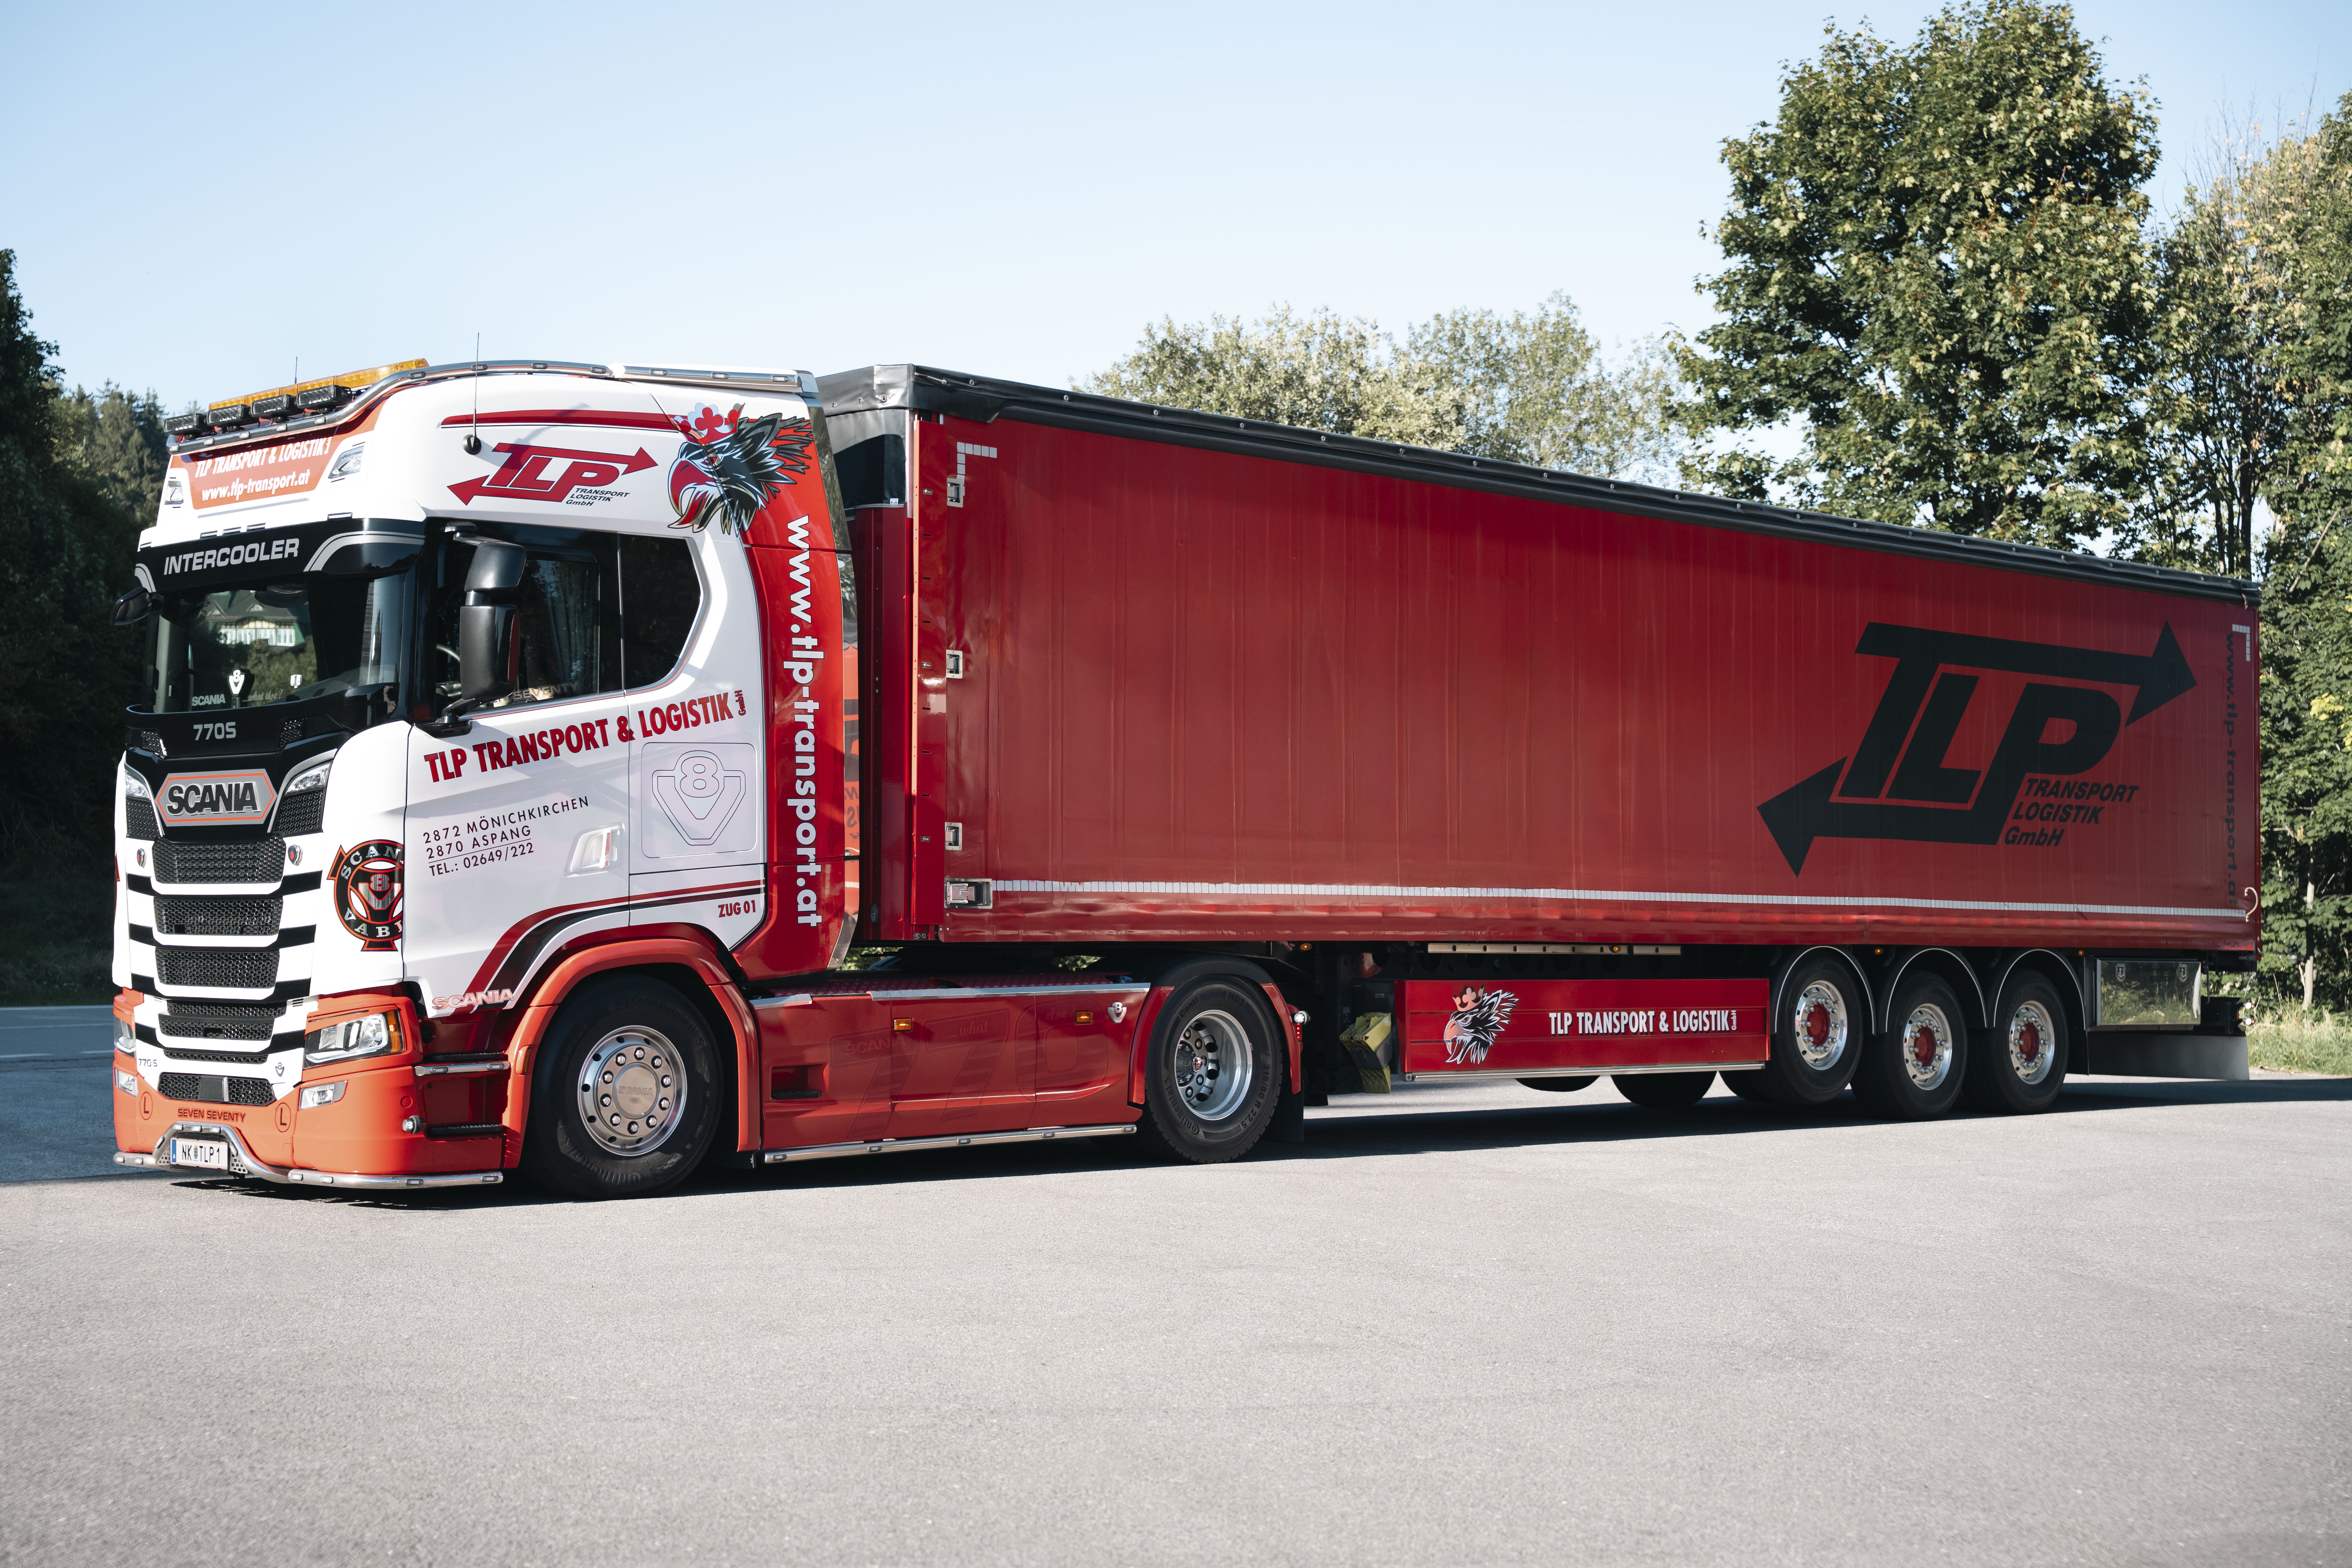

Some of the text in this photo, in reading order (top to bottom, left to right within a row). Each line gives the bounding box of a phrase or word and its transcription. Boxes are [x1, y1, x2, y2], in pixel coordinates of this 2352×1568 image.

[194, 460, 212, 478] TLP
[213, 448, 269, 472] TRANSPORT
[269, 447, 276, 462] &
[279, 438, 326, 461] LOGISTIK
[202, 470, 310, 501] www.tlp-transport.at
[487, 443, 620, 502] TLP
[570, 494, 612, 502] LOGISTIK
[575, 488, 630, 498] TRANSPORT
[164, 538, 299, 575] INTERCOOLER
[192, 694, 225, 706] SCANIA
[513, 681, 579, 701] SEVENTY
[193, 722, 237, 740] 770S
[784, 514, 824, 927] www.tlp-transport.at
[1837, 622, 2121, 845] TLP
[423, 689, 747, 783] TLP TRANSPORT & LOGISTIK GmbH
[2224, 633, 2238, 906] www.tlp-transport.at
[167, 782, 261, 816] SCANIA
[2024, 778, 2139, 803] TRANSPORT
[423, 795, 589, 844] 2872 MÖNICHKIRCHEN
[2012, 802, 2104, 825] LOGISTIK
[426, 825, 531, 859] 2870 ASPANG
[2005, 826, 2065, 847] GmbH
[341, 846, 403, 879] SCAN
[429, 842, 534, 876] TEL.: 02649/222
[718, 899, 756, 918] ZUG 01
[432, 988, 514, 1010] SCANIA
[1180, 990, 1245, 1017] Conti Hybrid HD3
[1549, 1012, 1572, 1035] TLP
[1577, 1011, 1654, 1034] TRANSPORT
[1659, 1011, 1669, 1032] &
[1673, 1009, 1730, 1032] LOGISTIK
[845, 1036, 906, 1054] SCANIA
[619, 1085, 654, 1096] SCANIA
[1241, 1063, 1269, 1129] 315/80 R 22.5
[144, 1097, 149, 1113] L
[178, 1108, 246, 1122] SEVEN SEVENTY
[280, 1108, 287, 1126] L
[1165, 1087, 1200, 1135] Continental
[182, 1144, 191, 1160] NK
